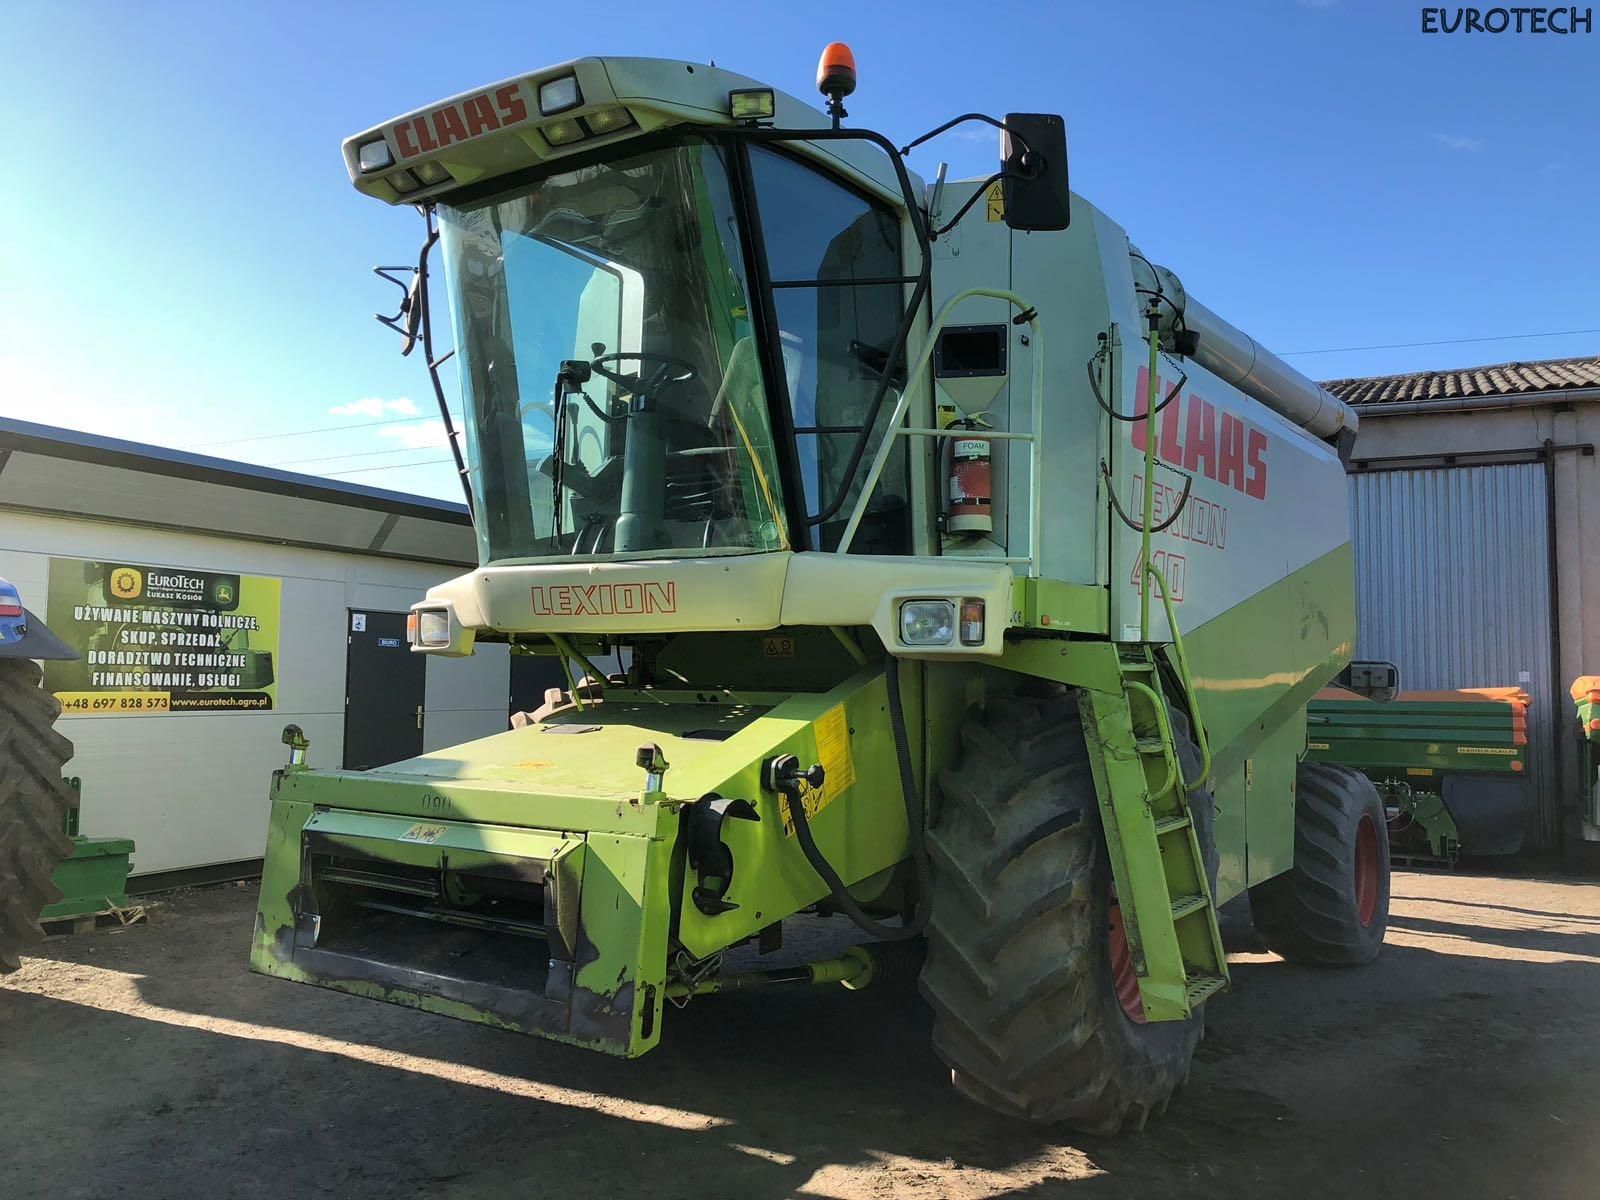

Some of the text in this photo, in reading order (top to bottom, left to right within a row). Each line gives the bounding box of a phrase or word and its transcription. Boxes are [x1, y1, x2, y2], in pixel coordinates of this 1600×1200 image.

[393, 83, 528, 158] CLAAS
[1131, 365, 1267, 500] CLAAS
[962, 442, 984, 450] FOAM
[1130, 475, 1227, 549] LEXION
[531, 582, 676, 616] LEXION
[74, 605, 260, 631] UŻYWANE MASZYNY ROLNICZE,
[121, 630, 221, 647] SKUP, SPRZEDAŻ
[88, 650, 246, 667] DORADZTWO TECHNICZNE
[92, 672, 240, 687] FINANSOWANIE, USŁUGI
[65, 698, 168, 709] +48 697 828 573
[171, 696, 267, 708] www.eurotech.agro.pl
